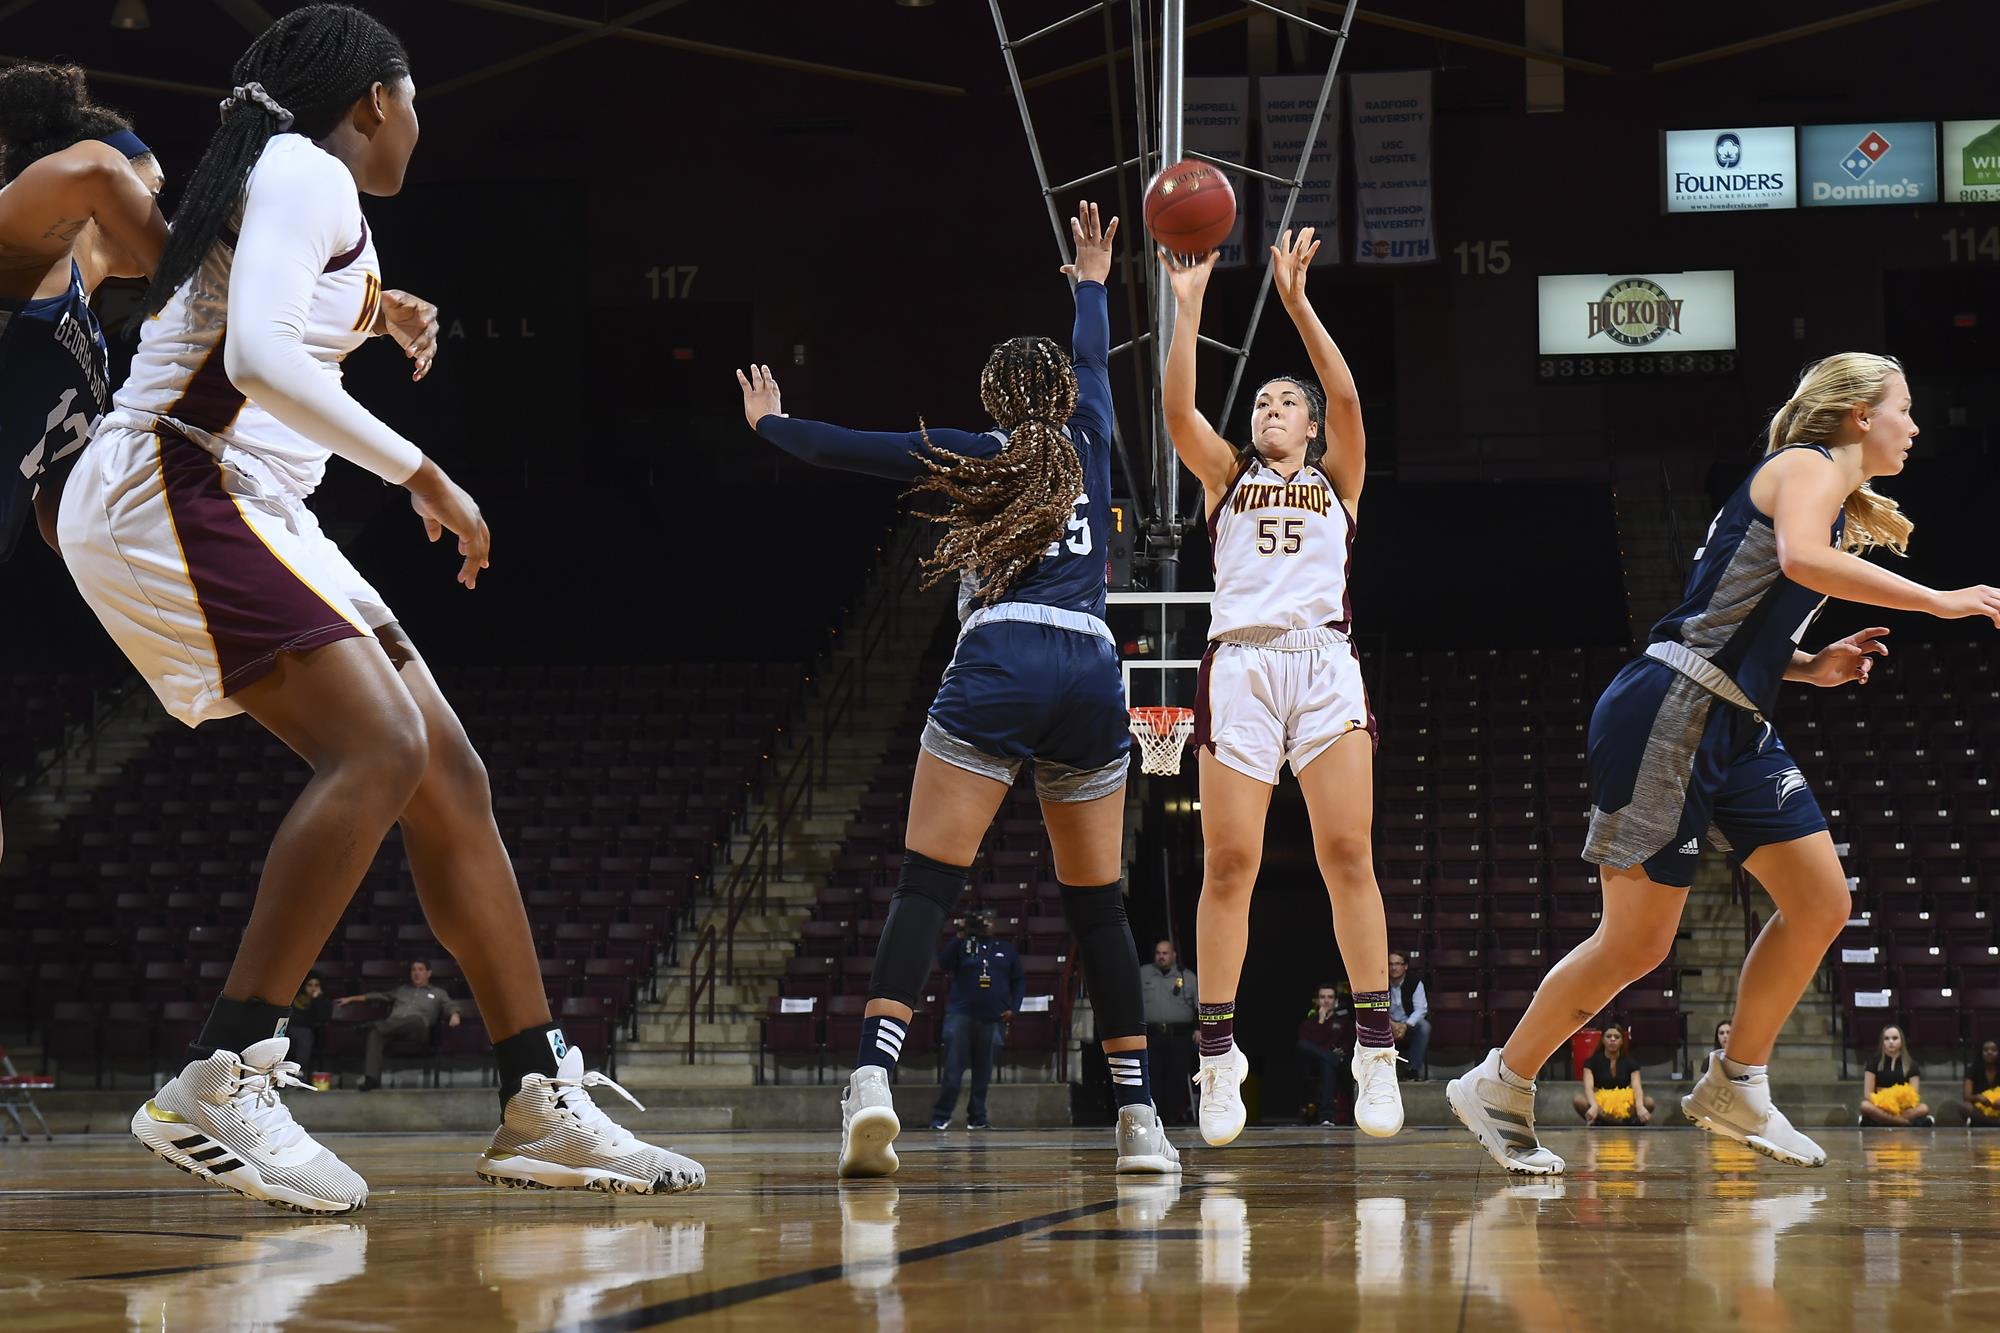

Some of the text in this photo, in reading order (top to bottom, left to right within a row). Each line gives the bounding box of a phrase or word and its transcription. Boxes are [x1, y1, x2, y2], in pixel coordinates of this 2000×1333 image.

[1268, 100, 1295, 109] HIGH
[1365, 100, 1418, 110] RADFORD
[1183, 116, 1240, 126] NIVERSITY
[1359, 112, 1424, 124] UNIVERSITY
[1273, 140, 1328, 149] HAMPON
[1381, 140, 1404, 149] USC
[1369, 153, 1417, 164] UPSTATE
[1971, 156, 2000, 169] WI
[1675, 172, 1784, 193] FOUNDERS
[1812, 178, 1920, 201] Domino's
[1366, 205, 1423, 215] WINTHROP
[1453, 240, 1511, 274] 115
[645, 264, 698, 300] 117
[1587, 299, 1684, 339] HICKORY
[1233, 483, 1332, 517] WINTHROP
[1255, 516, 1306, 558] 55
